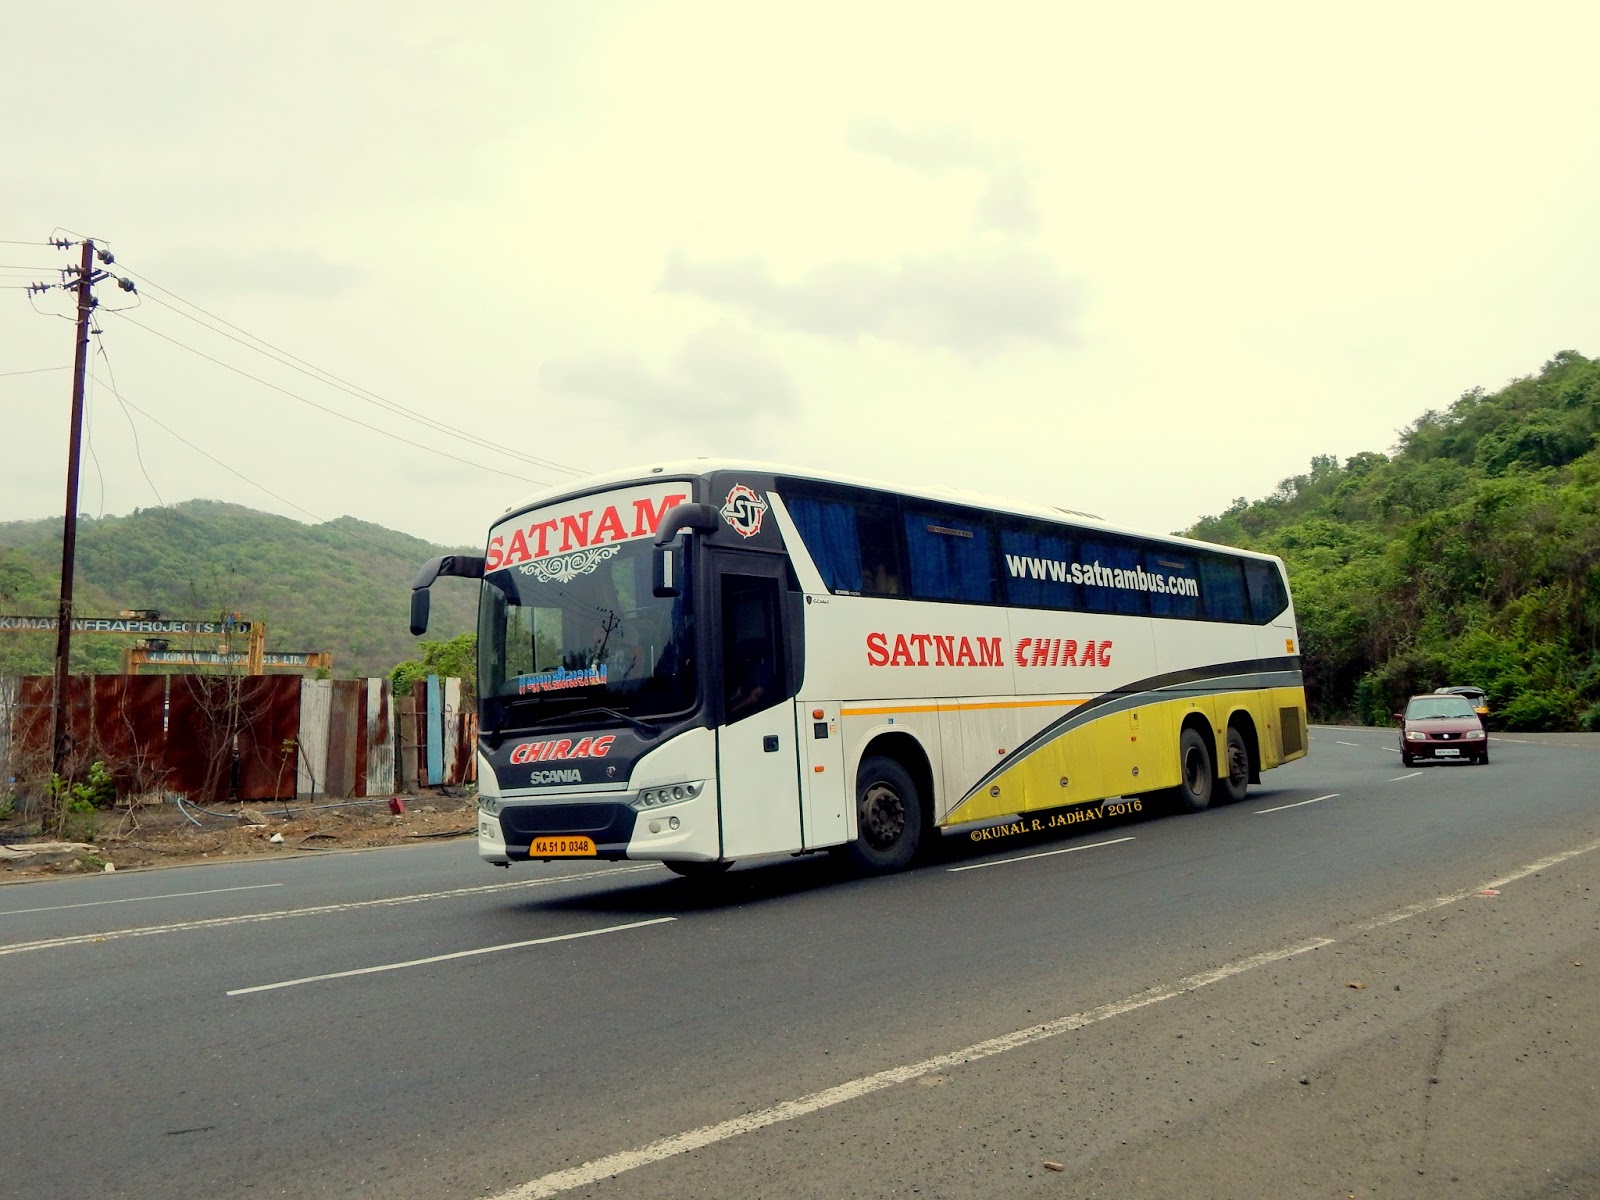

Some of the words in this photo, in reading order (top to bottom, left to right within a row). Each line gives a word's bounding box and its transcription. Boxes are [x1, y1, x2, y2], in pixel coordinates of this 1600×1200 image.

[486, 494, 687, 571] SATNAM
[1005, 553, 1199, 597] www.satnambus.com
[866, 632, 1004, 667] SATNAM
[1014, 637, 1113, 668] CHIRAG
[510, 735, 616, 765] CHIRAG
[530, 769, 582, 785] SCANIA
[536, 842, 547, 853] KA
[549, 841, 558, 852] 51
[560, 841, 566, 852] D
[569, 840, 589, 852] 0348
